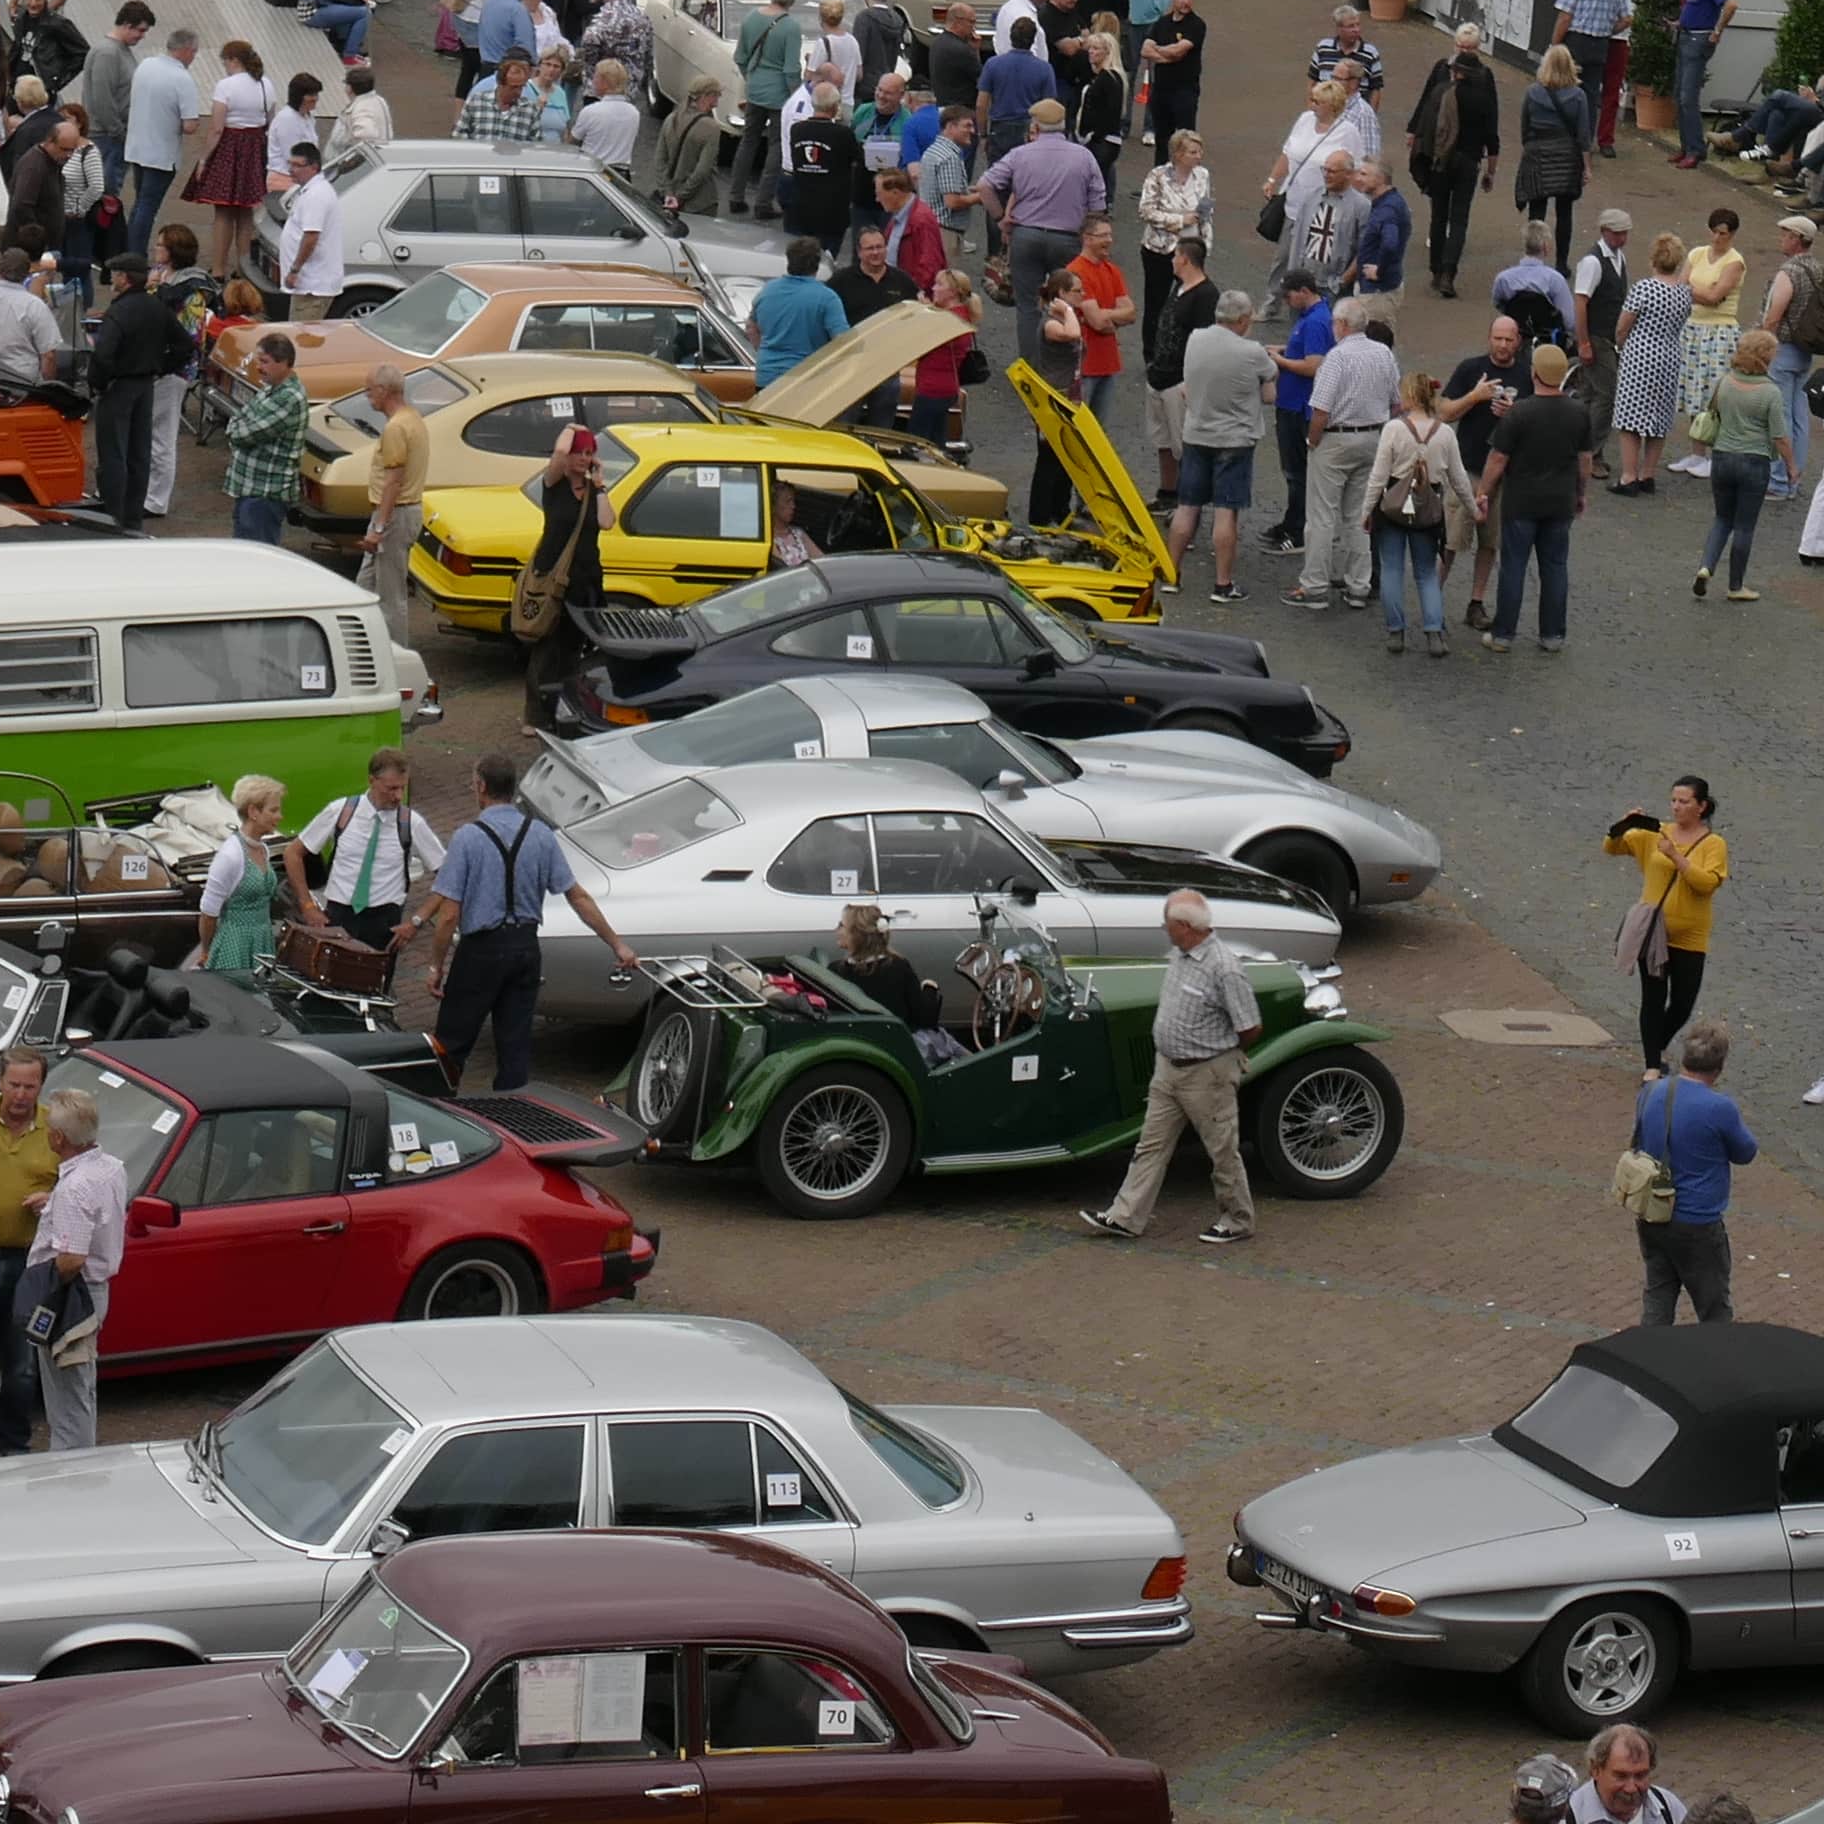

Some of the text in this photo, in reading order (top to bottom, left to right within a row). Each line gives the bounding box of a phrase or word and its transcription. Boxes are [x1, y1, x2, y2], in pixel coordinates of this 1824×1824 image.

[852, 641, 866, 651] 46
[307, 671, 321, 682] 73
[800, 747, 816, 757] 82
[124, 861, 146, 873] 126
[837, 876, 852, 888] 27
[398, 1130, 413, 1143] 18
[770, 1482, 798, 1496] 113
[1673, 1538, 1694, 1552] 92
[827, 1709, 848, 1724] 70
